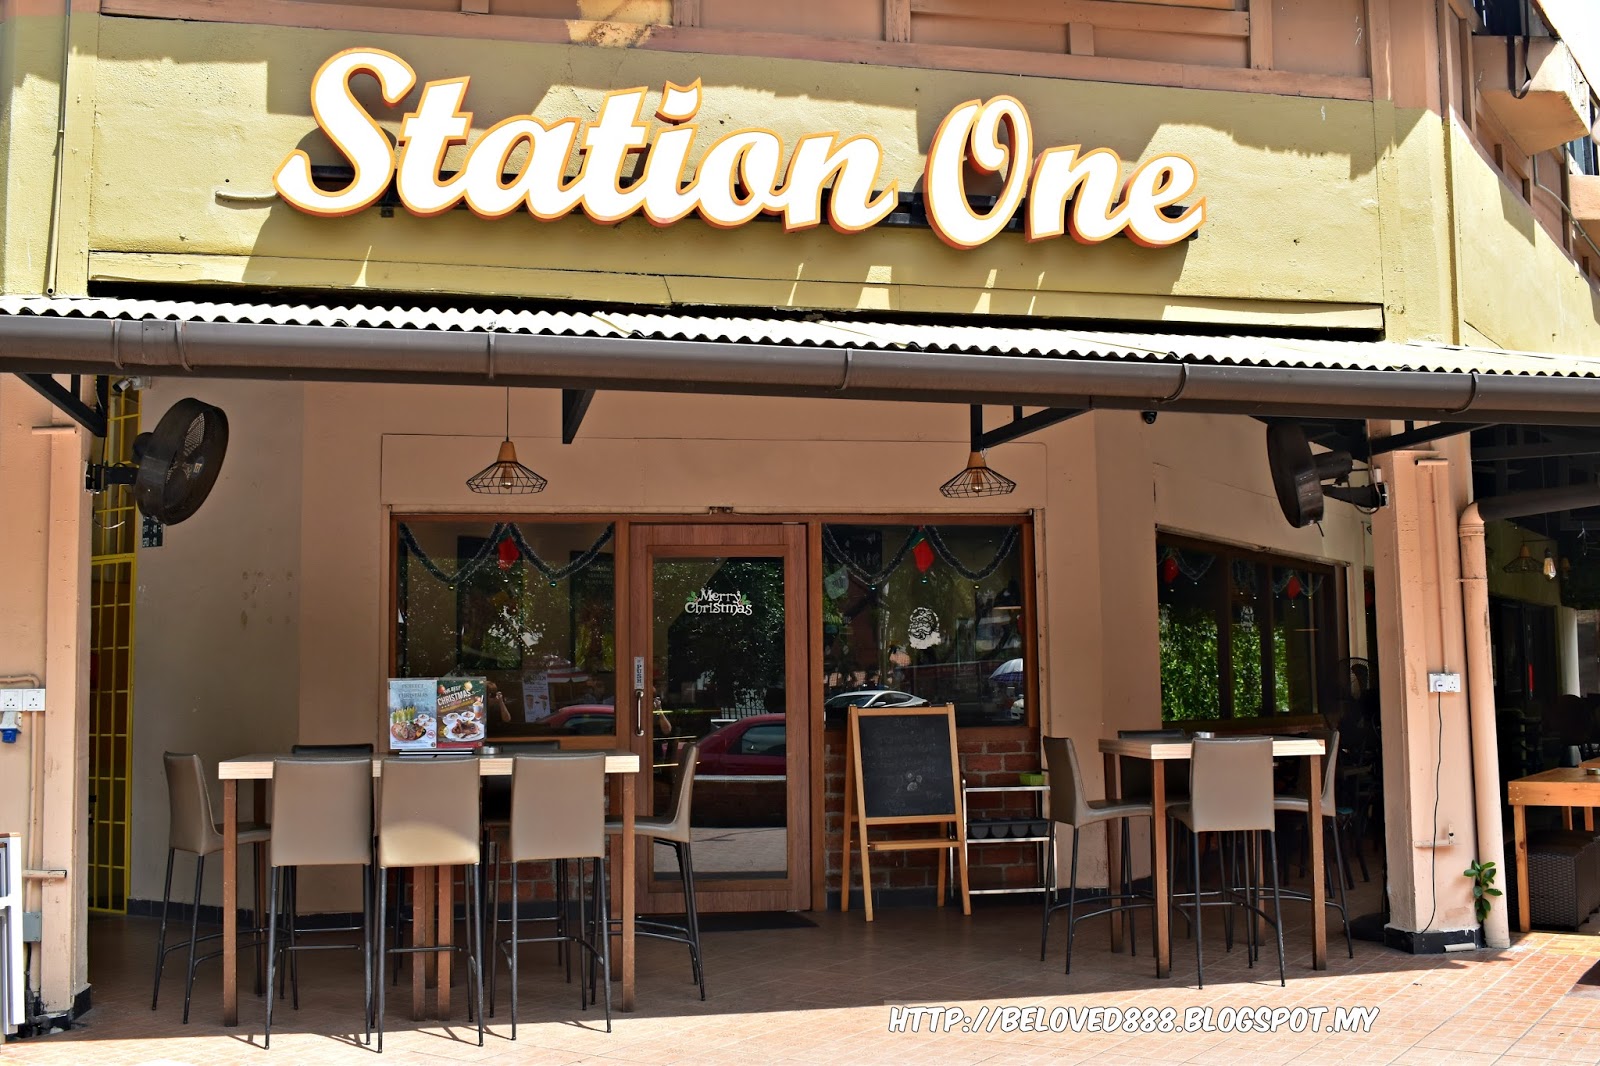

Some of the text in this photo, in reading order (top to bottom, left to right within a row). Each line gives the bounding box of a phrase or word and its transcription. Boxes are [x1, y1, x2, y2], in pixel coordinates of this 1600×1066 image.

[274, 46, 1207, 250] Station One
[699, 587, 741, 604] Merry
[685, 601, 752, 616] Christmas
[437, 689, 471, 706] CHRISTMAS
